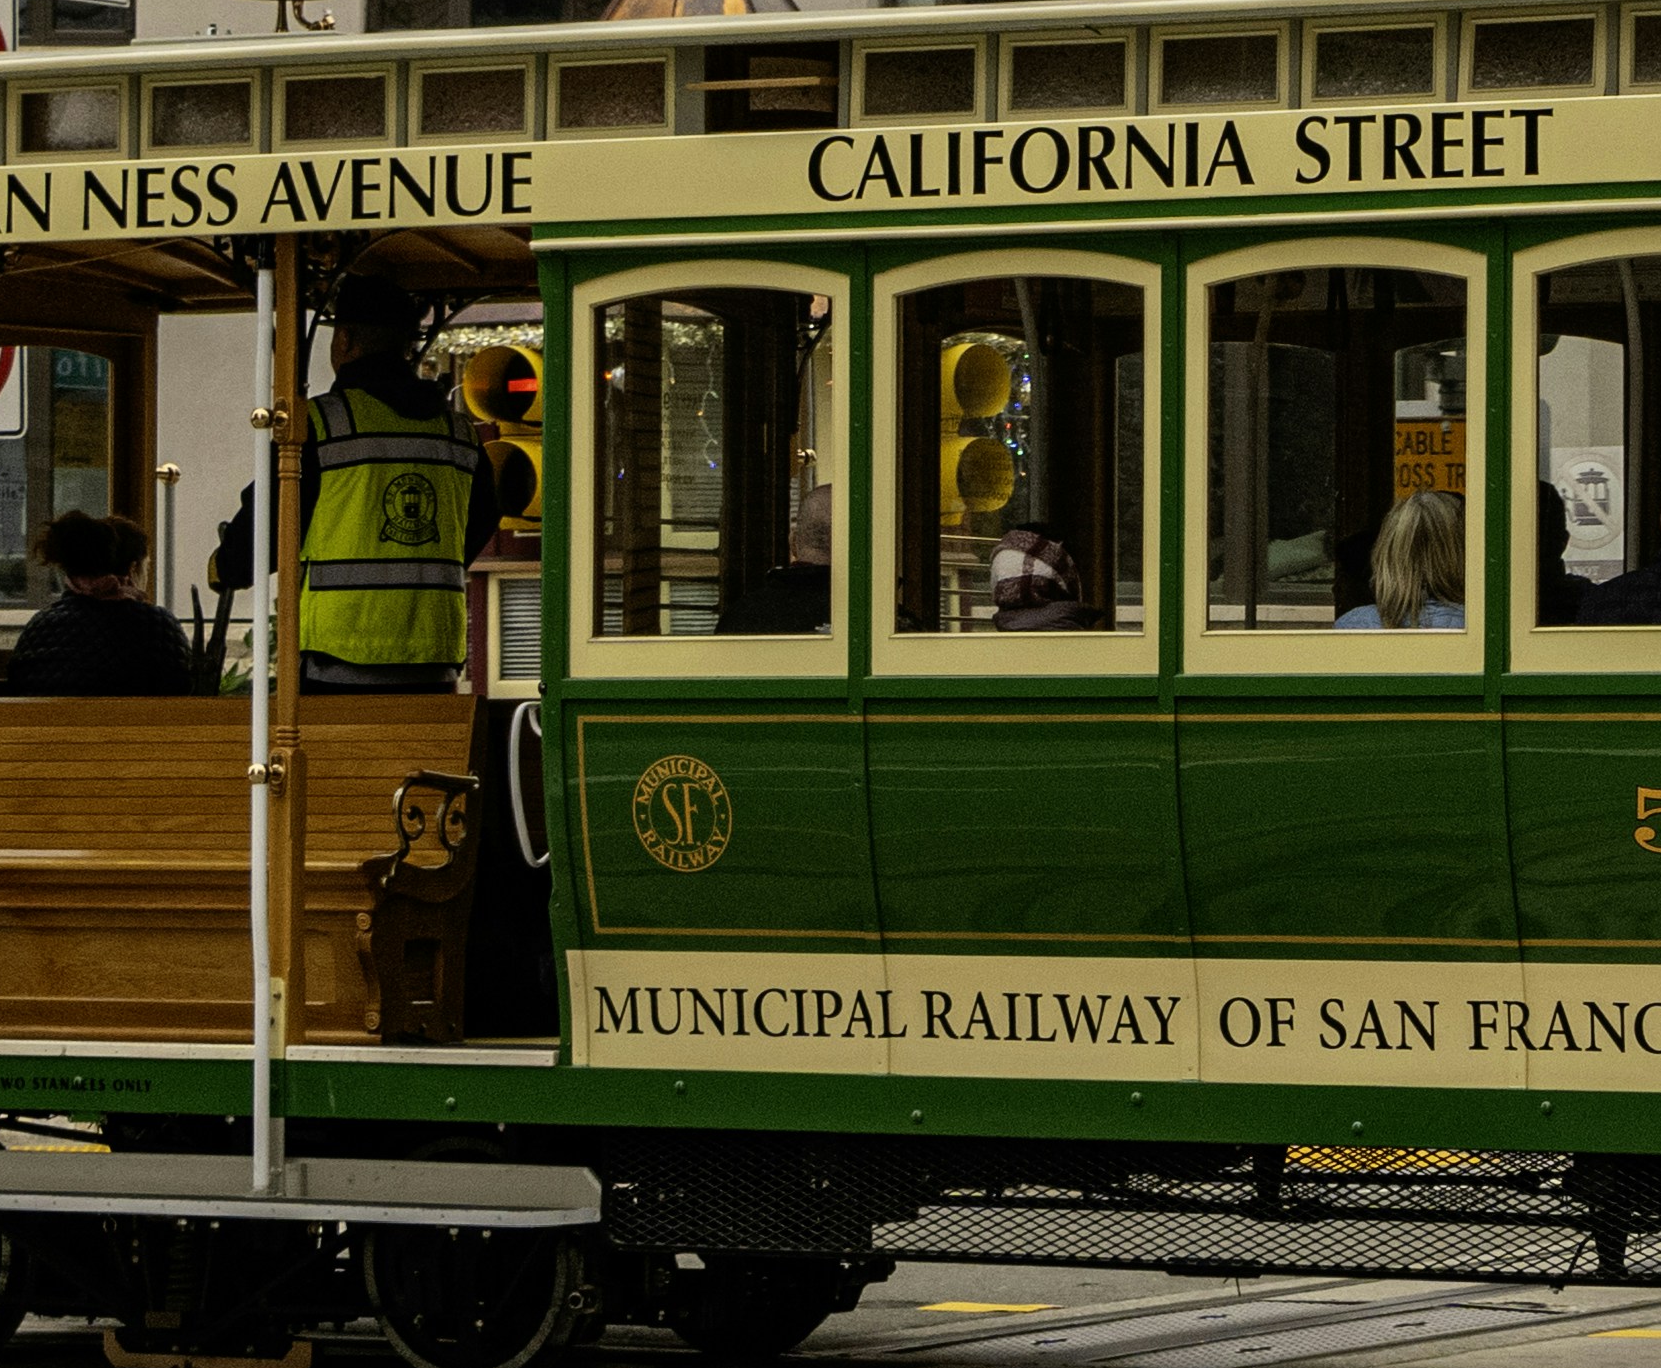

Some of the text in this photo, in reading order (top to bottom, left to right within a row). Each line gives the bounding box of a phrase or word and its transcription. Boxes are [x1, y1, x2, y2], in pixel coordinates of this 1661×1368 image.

[807, 108, 1554, 203] CALIFORNIA STREET
[82, 163, 239, 231] NESS
[260, 151, 534, 224] AVENUE
[637, 759, 724, 805] MUNICIPAL
[642, 827, 726, 868] RAILWAY
[593, 986, 908, 1039] MUNICIPAL
[920, 989, 1181, 1046] RAILWAY
[1218, 997, 1297, 1048] OF
[1319, 997, 1440, 1051] SAN
[112, 1078, 152, 1092] ONLY
